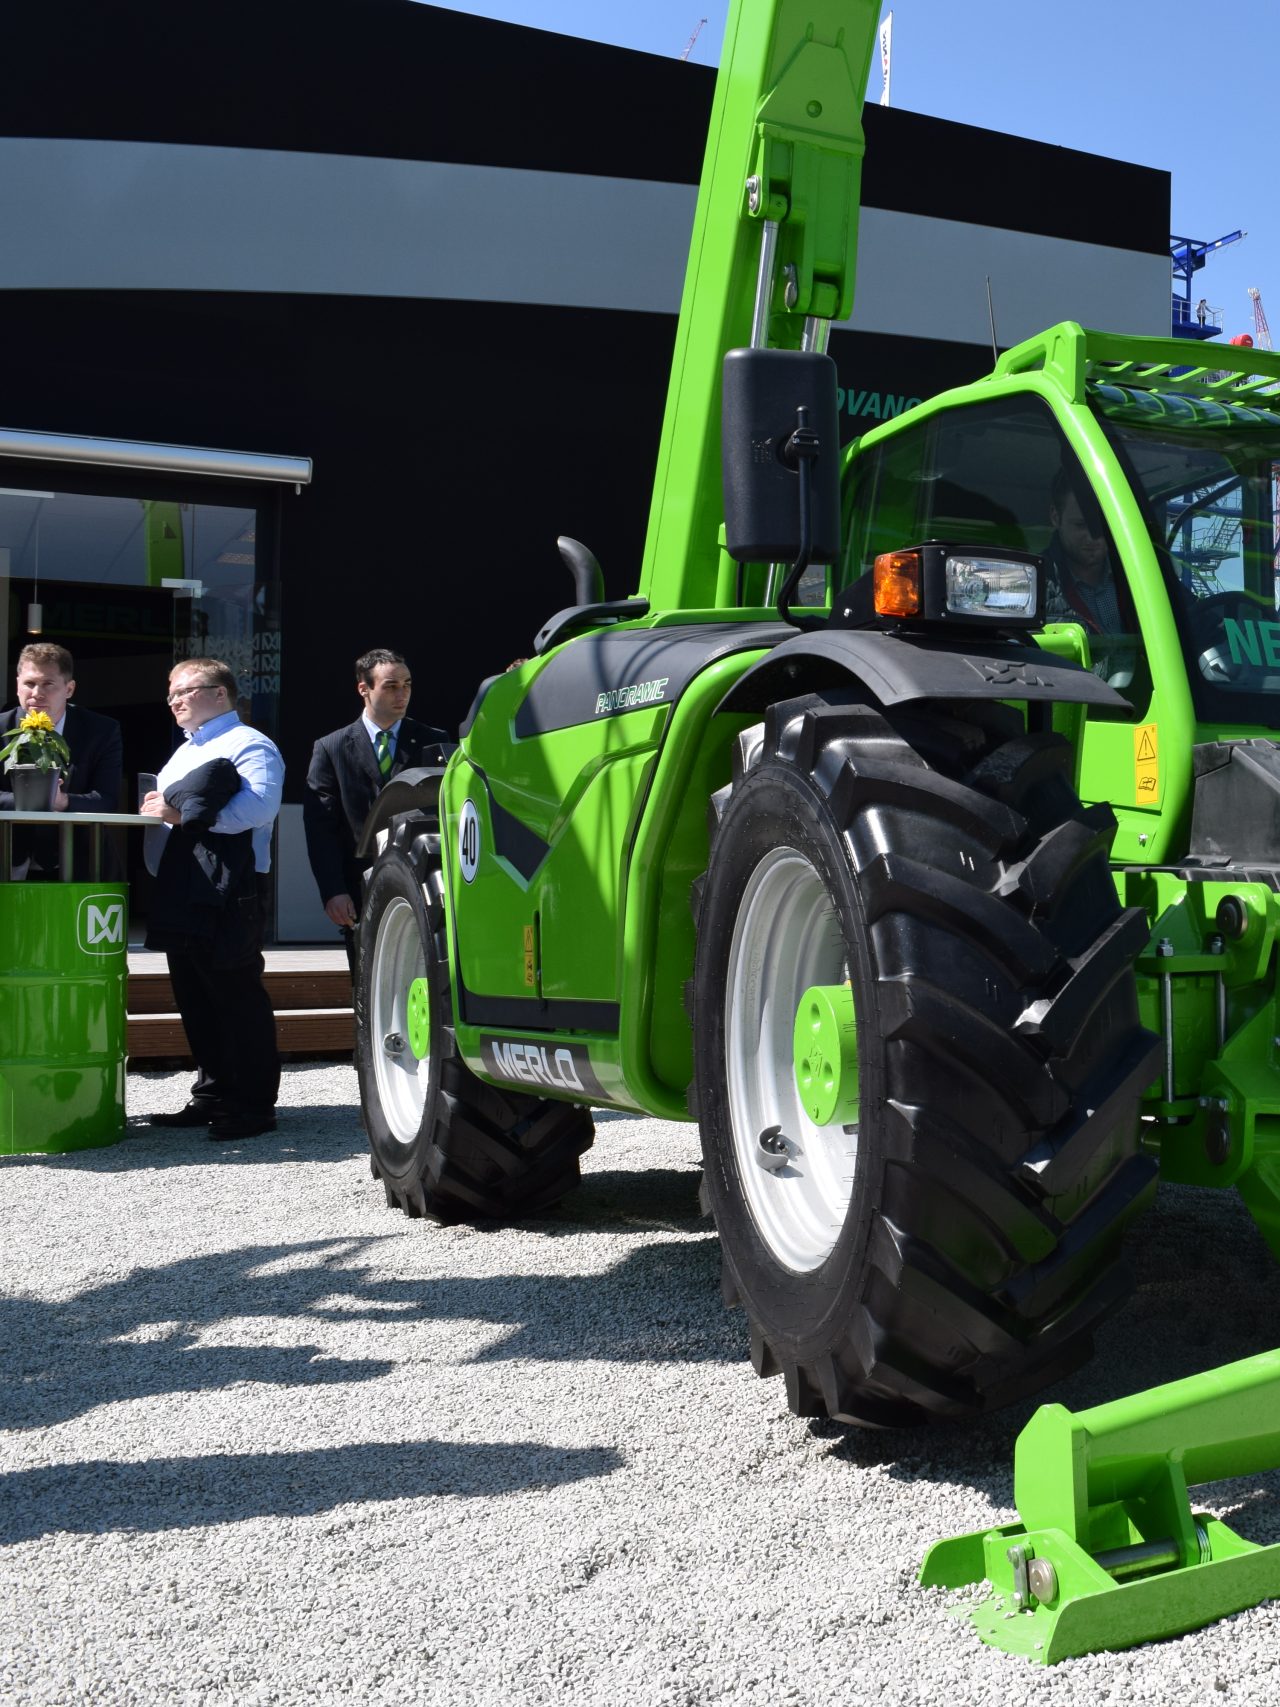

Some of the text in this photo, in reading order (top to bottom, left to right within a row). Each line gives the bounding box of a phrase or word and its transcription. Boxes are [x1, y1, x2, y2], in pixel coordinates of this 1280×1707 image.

[595, 677, 669, 714] PANORAMIC
[461, 815, 476, 866] 40
[492, 1041, 585, 1092] MERLO
